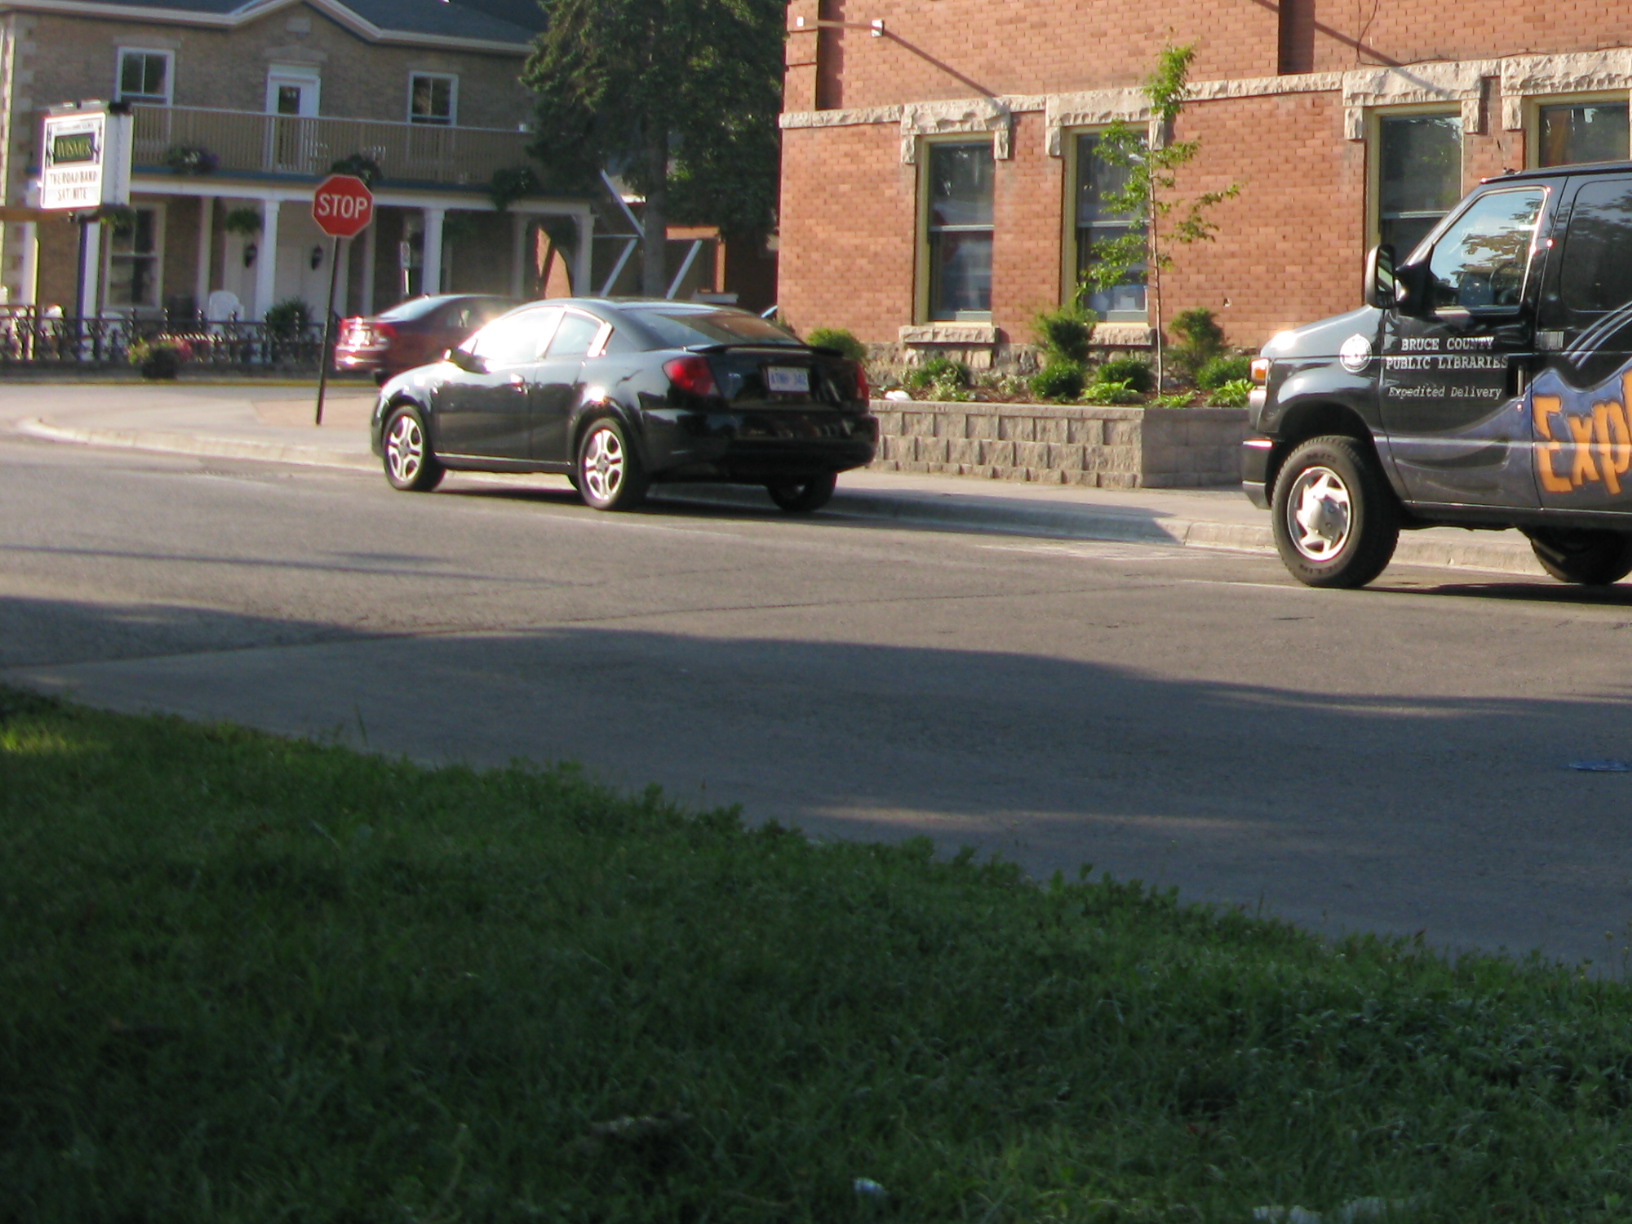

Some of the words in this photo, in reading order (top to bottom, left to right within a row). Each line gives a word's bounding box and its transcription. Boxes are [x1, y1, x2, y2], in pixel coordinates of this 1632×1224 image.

[317, 193, 368, 219] STOP
[1400, 337, 1440, 352] BRUCE
[1446, 336, 1495, 351] COUNTY
[1386, 357, 1431, 370] PUBLIC
[1438, 355, 1509, 369] LIBRARIES
[1388, 386, 1445, 400] Expedited
[1450, 386, 1502, 400] Delivery
